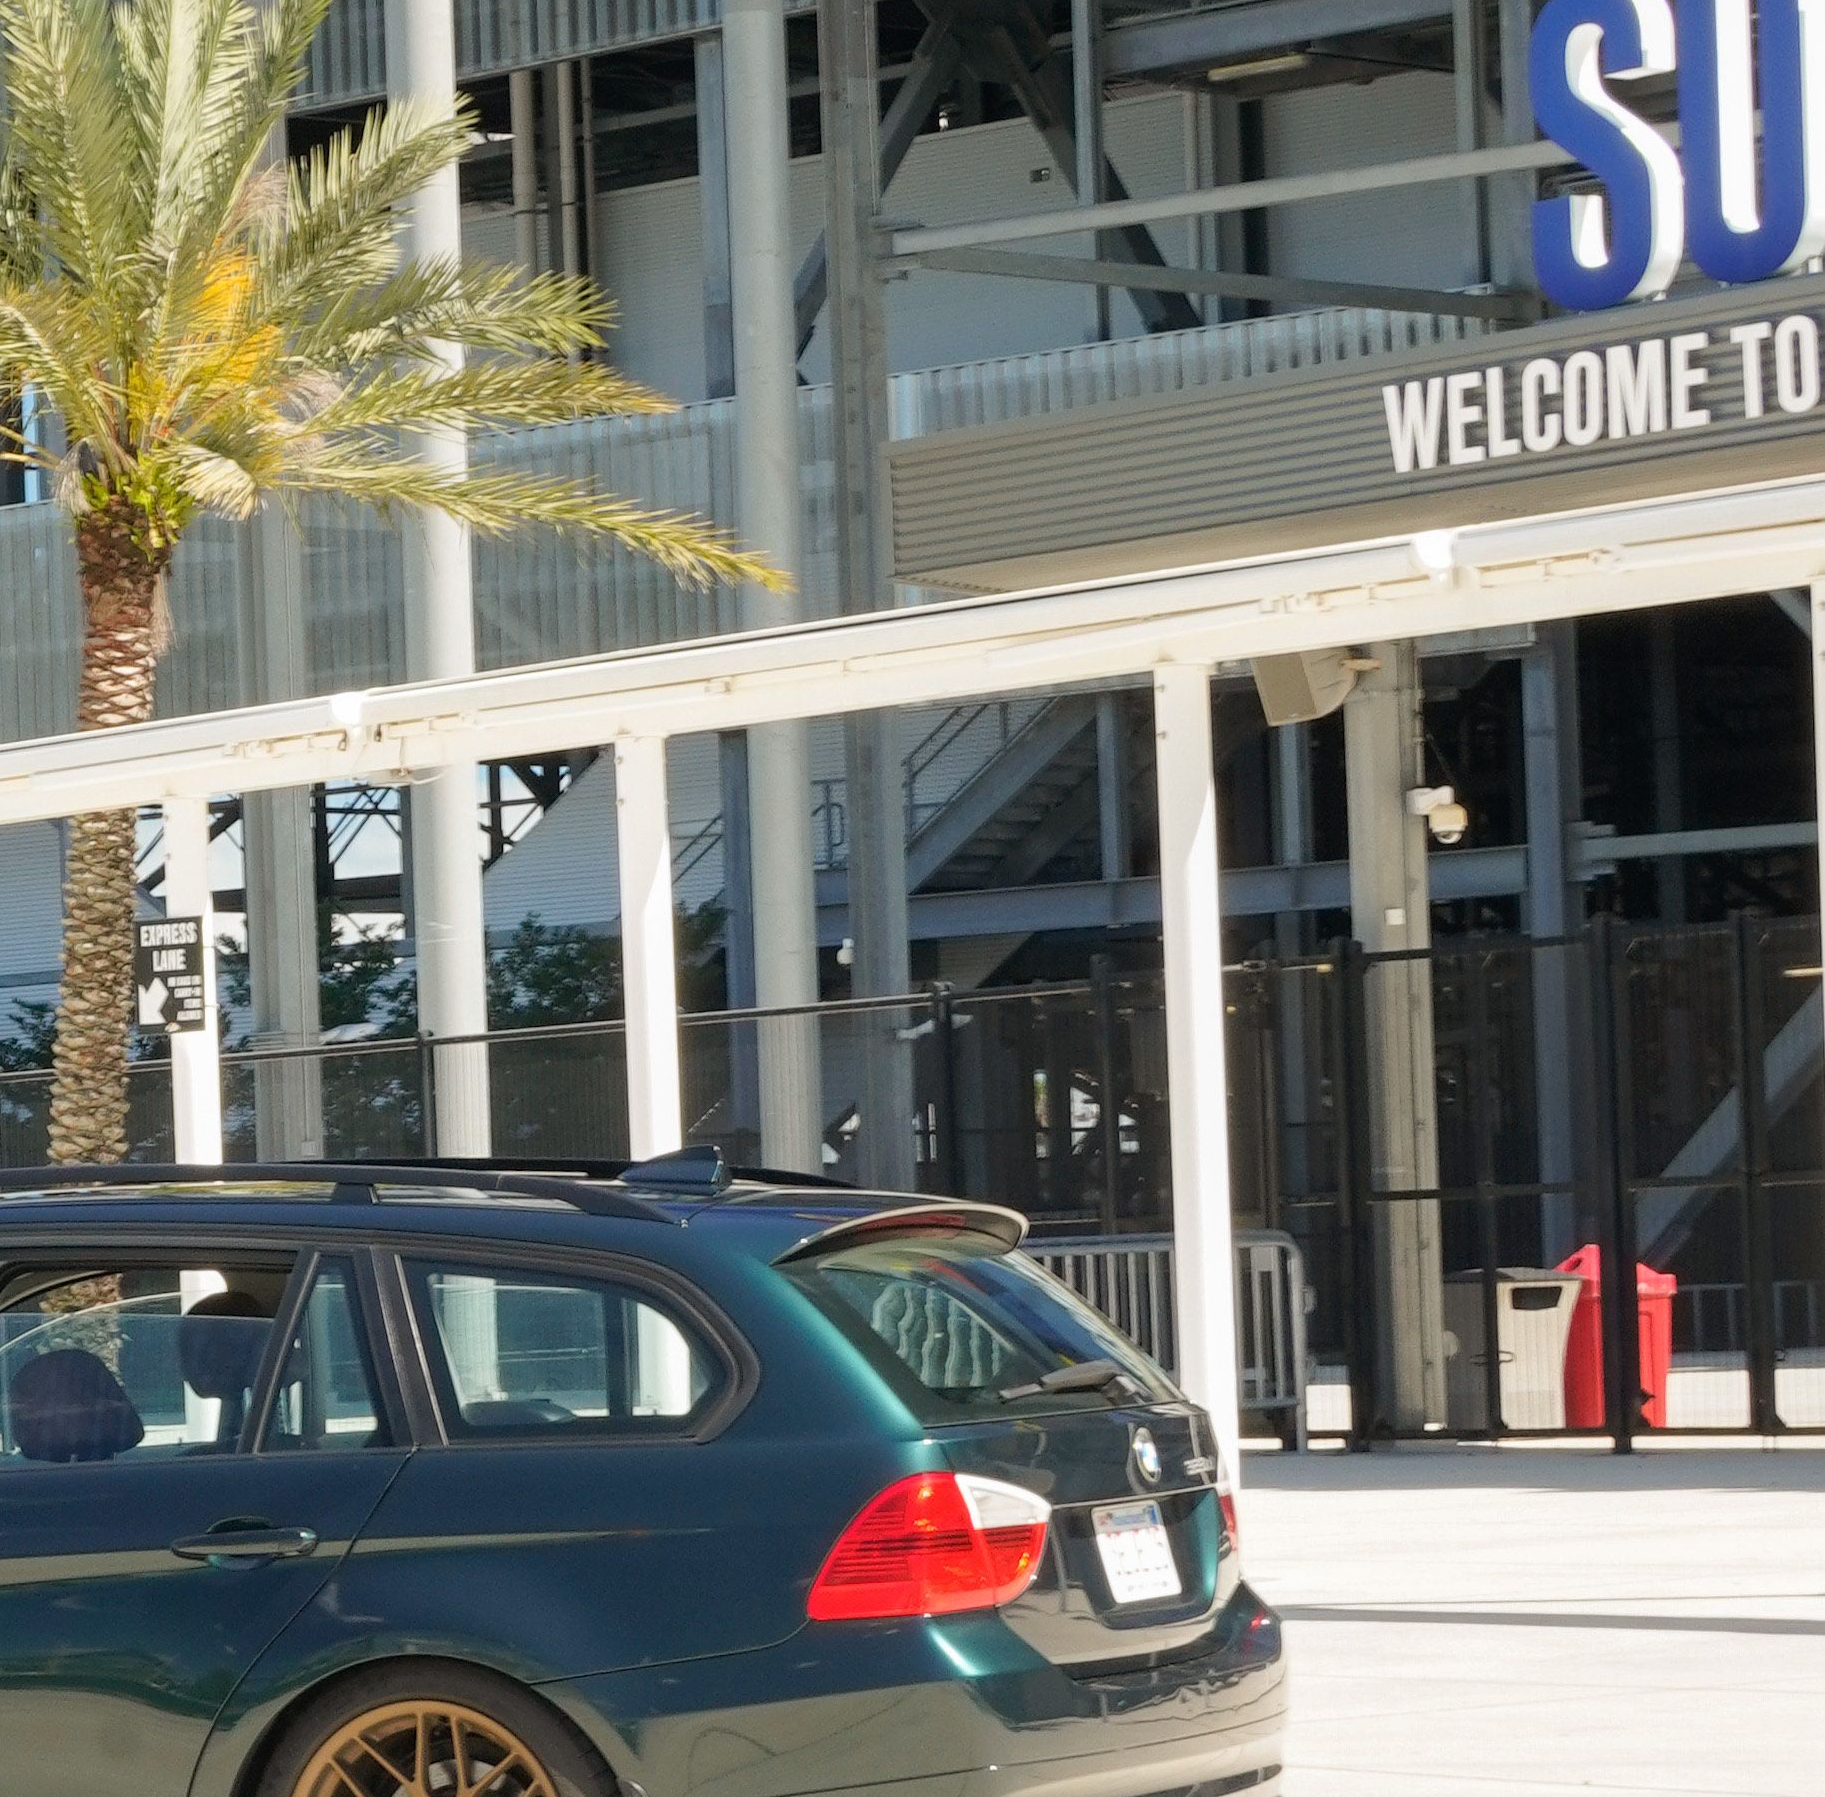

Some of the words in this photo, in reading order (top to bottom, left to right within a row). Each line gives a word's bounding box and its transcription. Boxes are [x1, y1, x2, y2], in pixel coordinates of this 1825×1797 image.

[1381, 331, 1712, 474] WELCOME
[1729, 314, 1820, 419] TO
[140, 921, 198, 947] EXPRESS
[153, 948, 187, 972] LANE
